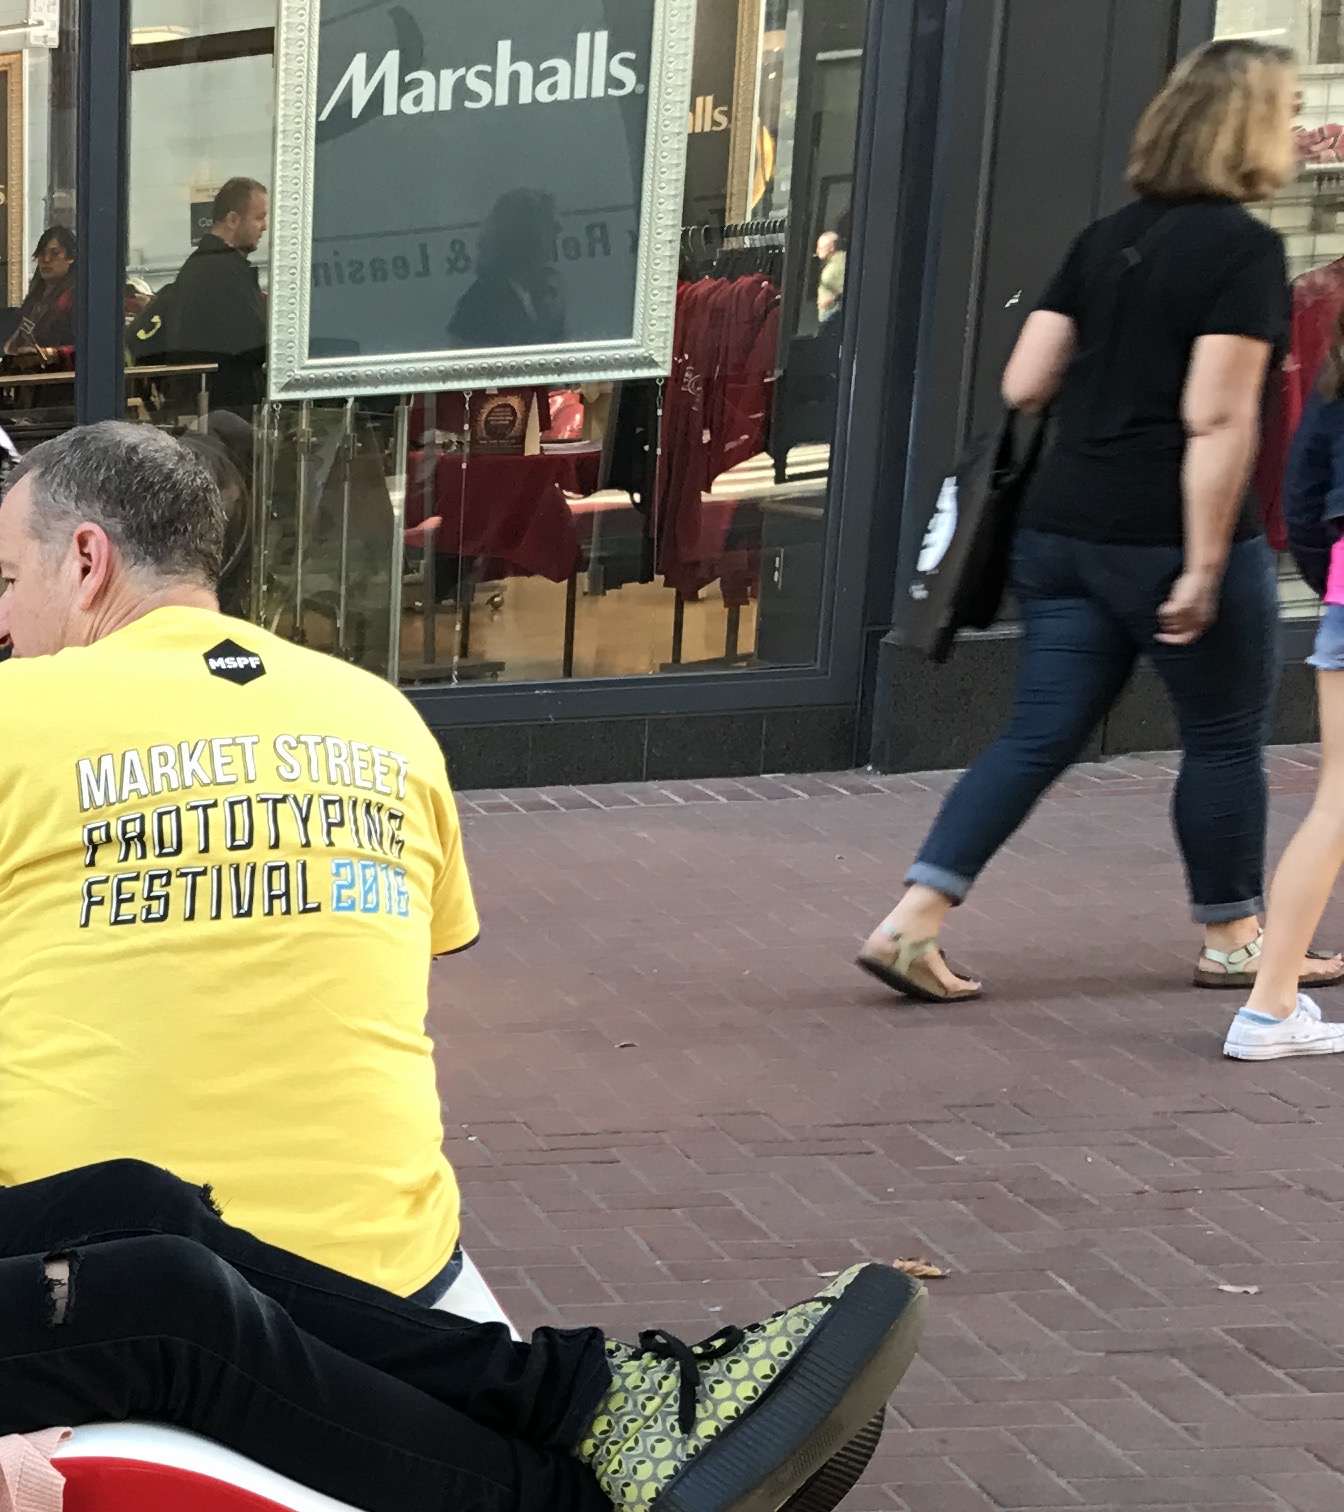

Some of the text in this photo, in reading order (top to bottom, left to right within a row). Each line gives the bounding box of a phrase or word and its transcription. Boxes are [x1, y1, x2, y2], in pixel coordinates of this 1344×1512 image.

[318, 30, 637, 121] Marshalls
[208, 656, 261, 670] MSPF
[75, 734, 409, 813] MARKET STREET
[82, 792, 406, 868] PROTOTYPING
[79, 857, 410, 928] FESTIVAL 2016
